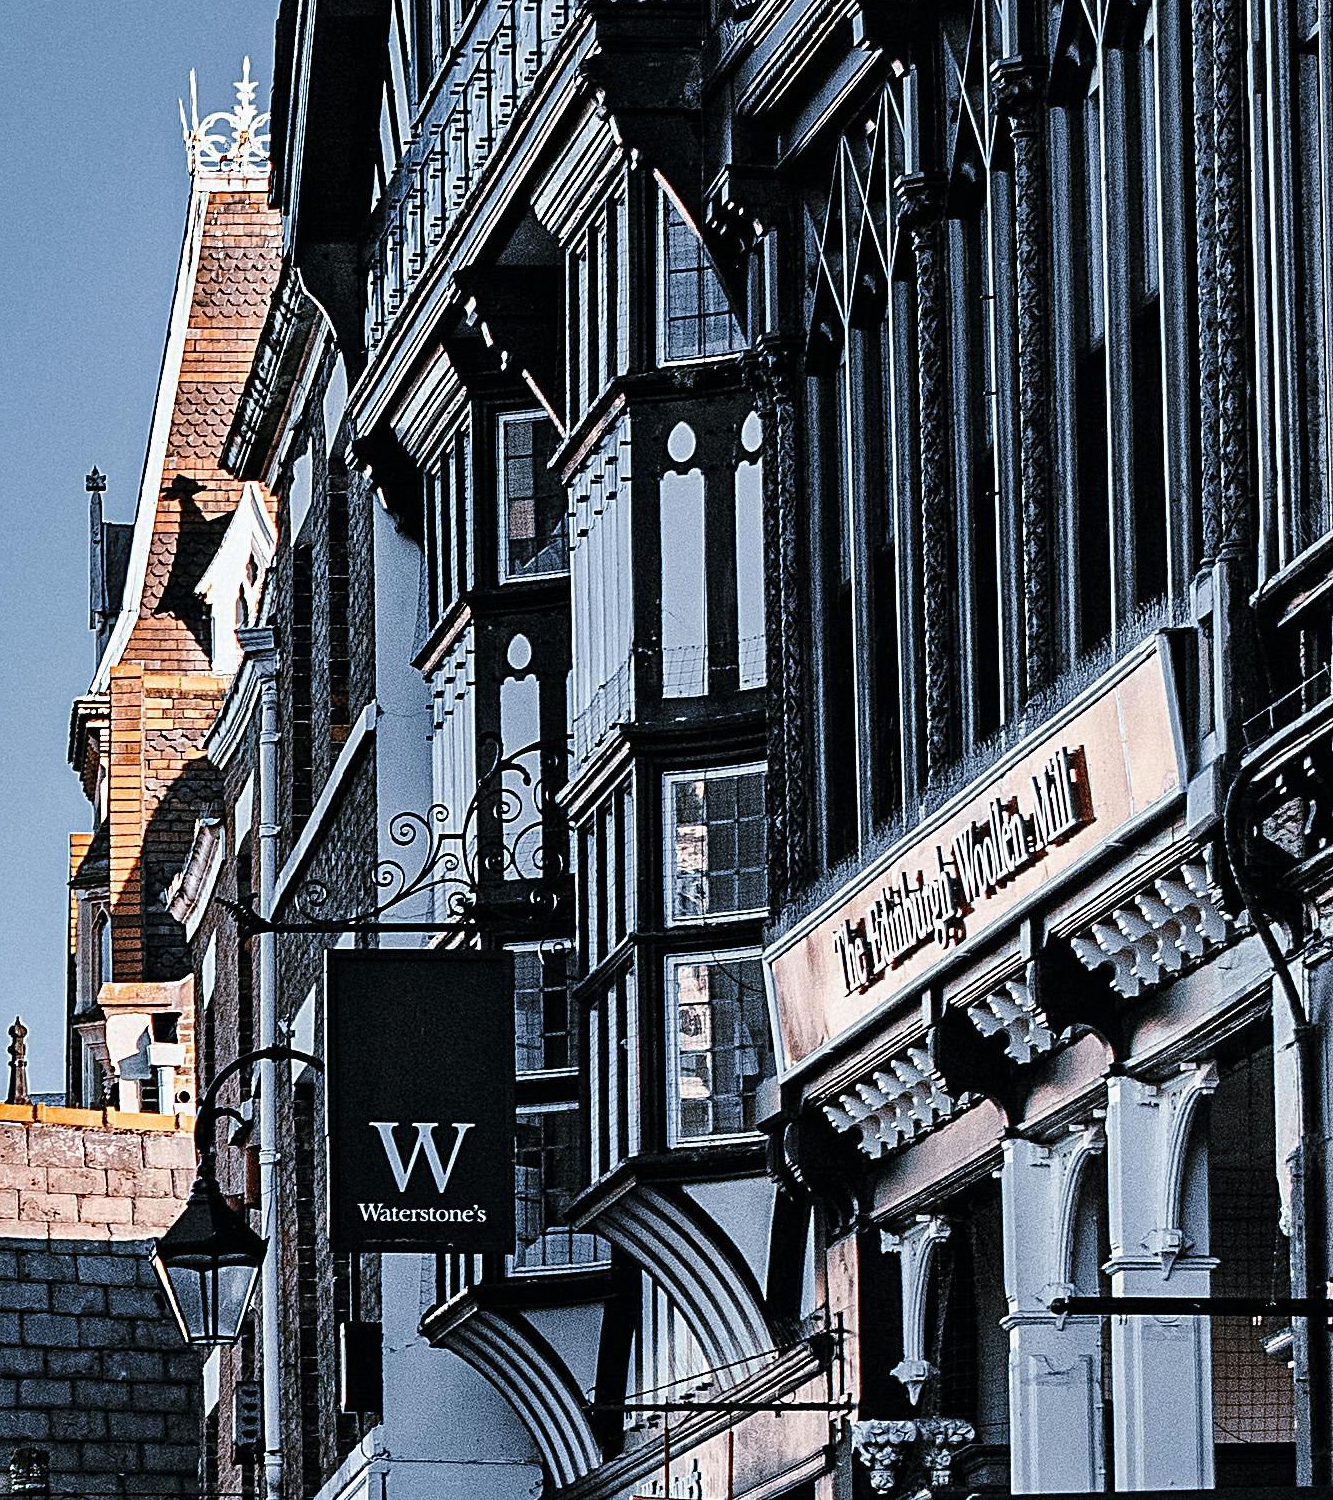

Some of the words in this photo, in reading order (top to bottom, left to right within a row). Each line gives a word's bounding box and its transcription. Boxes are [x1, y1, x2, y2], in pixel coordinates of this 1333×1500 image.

[833, 920, 868, 994] The
[867, 848, 958, 949] Edinburgh
[952, 799, 1030, 904] Woollen
[1029, 748, 1077, 852] Mill
[369, 1122, 475, 1193] W
[357, 1203, 486, 1222] Waterstone's
